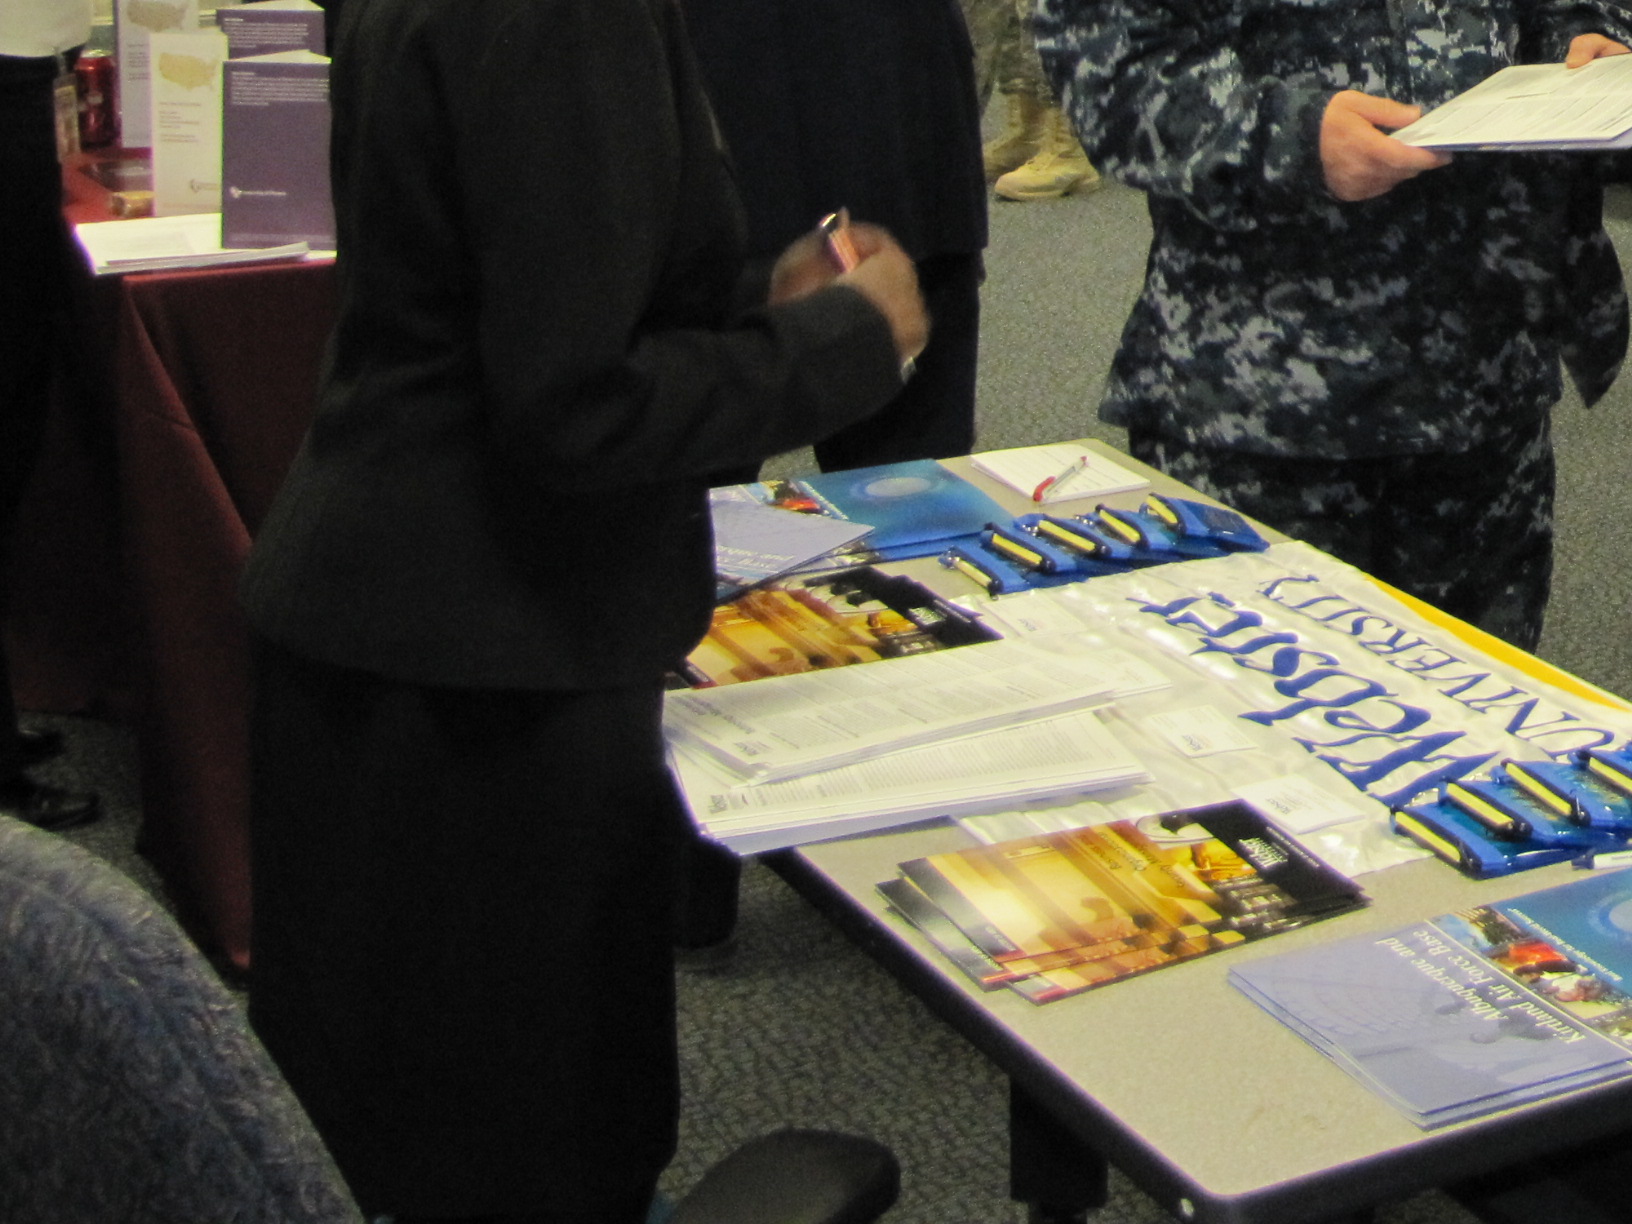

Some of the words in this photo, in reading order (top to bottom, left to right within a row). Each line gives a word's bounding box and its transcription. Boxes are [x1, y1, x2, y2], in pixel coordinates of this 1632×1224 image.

[1259, 573, 1615, 761] UNIVERSITY
[1126, 590, 1500, 808] Webster
[1374, 936, 1416, 964] and
[1412, 929, 1452, 958] Base
[1413, 956, 1508, 1021] Albuquerque
[1448, 953, 1493, 987] Force
[1487, 982, 1521, 1006] Air
[1515, 1000, 1586, 1044] Kirtland
